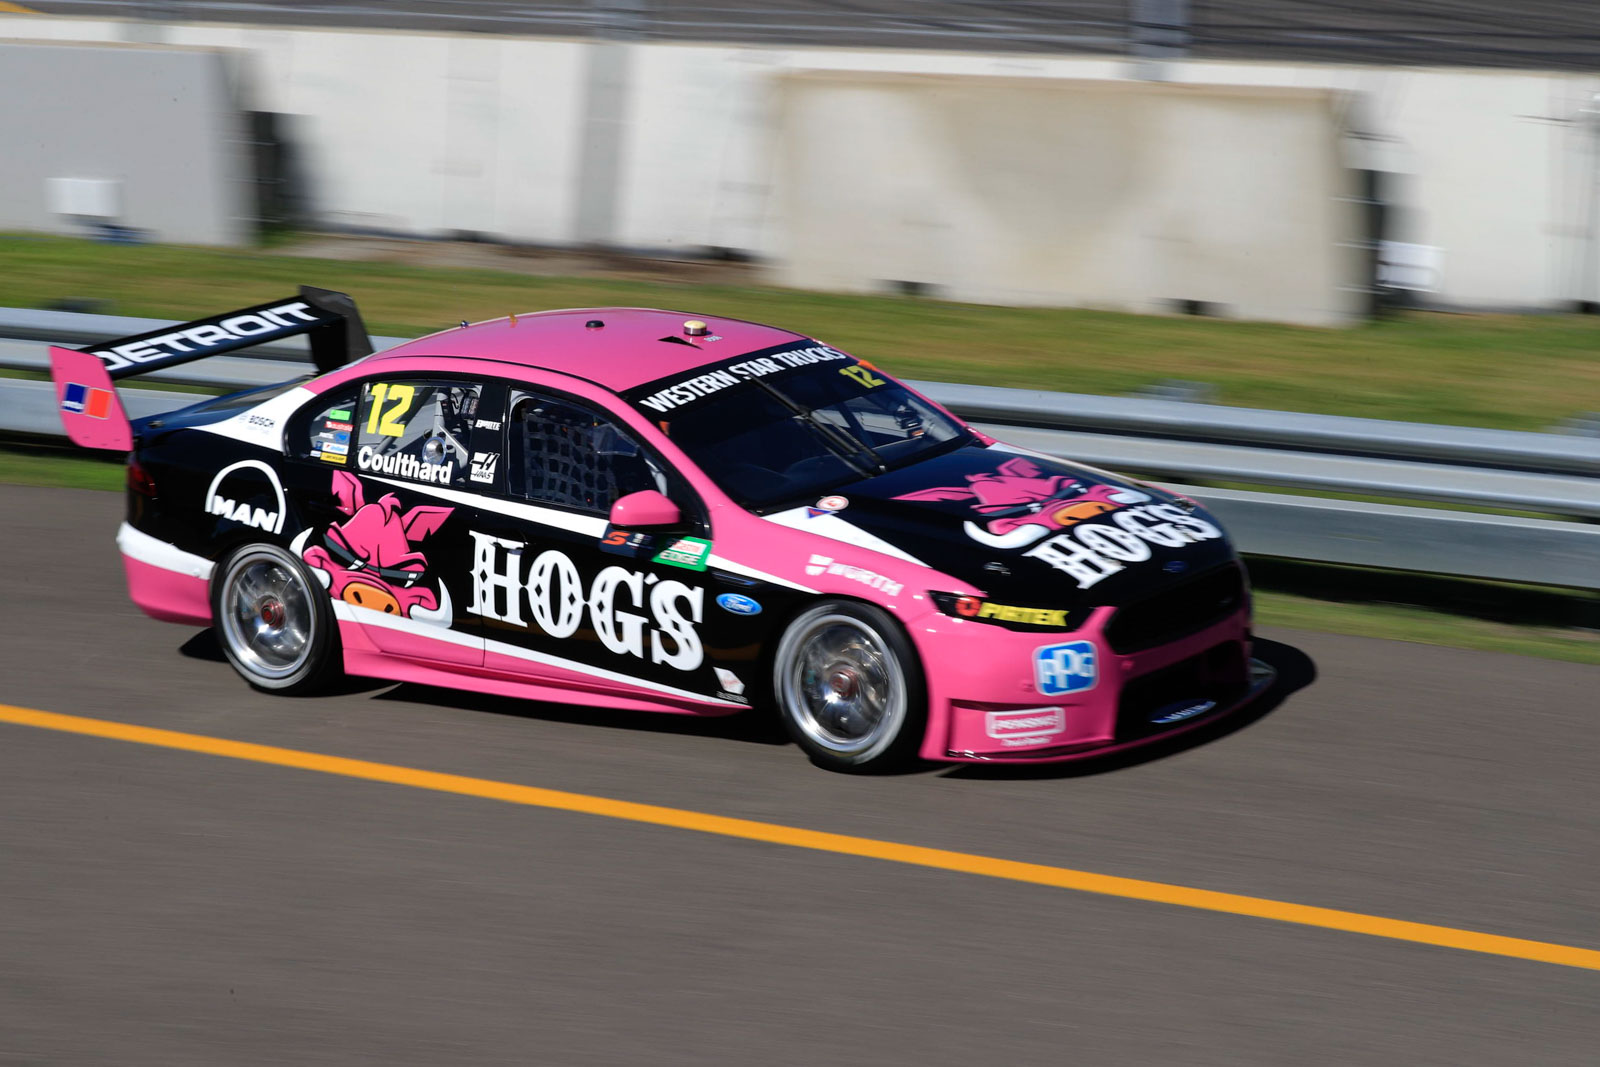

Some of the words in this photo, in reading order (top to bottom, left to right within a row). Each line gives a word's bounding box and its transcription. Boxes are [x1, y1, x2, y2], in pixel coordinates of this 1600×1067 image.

[639, 369, 741, 413] WESTERN
[728, 356, 786, 381] STAR
[773, 346, 847, 368] TRUCKS
[838, 365, 886, 389] 12
[366, 383, 415, 437] 12
[358, 445, 453, 484] Coulthard
[211, 494, 279, 533] MAN
[659, 549, 702, 566] EDGE
[1036, 649, 1096, 688] PPG
